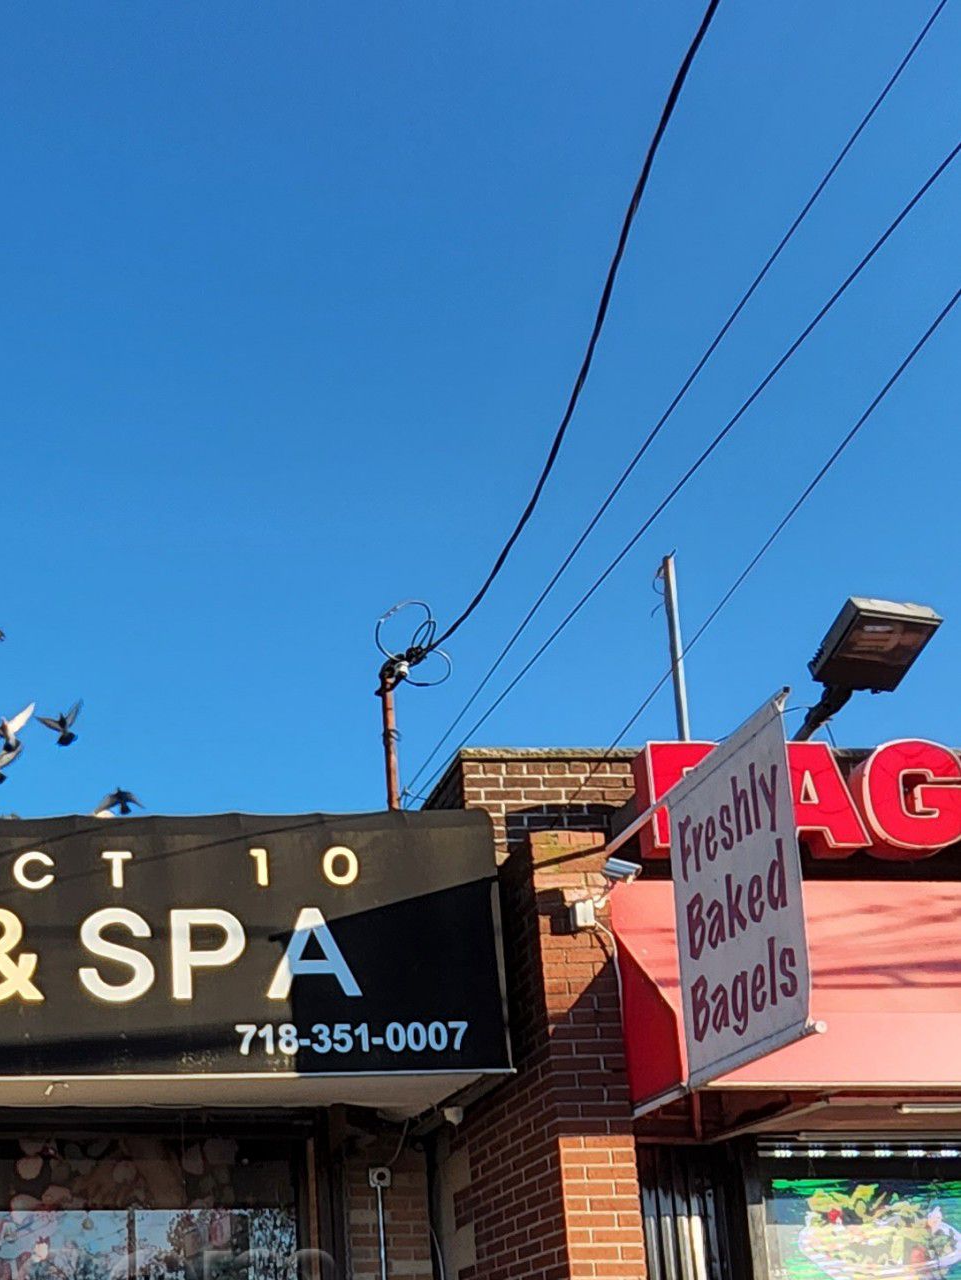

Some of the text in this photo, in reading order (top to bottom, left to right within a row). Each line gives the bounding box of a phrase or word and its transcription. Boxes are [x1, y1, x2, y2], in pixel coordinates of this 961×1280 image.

[249, 846, 360, 887] 10
[678, 762, 778, 883] Freshly
[686, 838, 788, 961] Baked
[78, 906, 363, 1002] SPA
[691, 936, 798, 1043] Bagels
[234, 1021, 468, 1056] 718-351-0007
